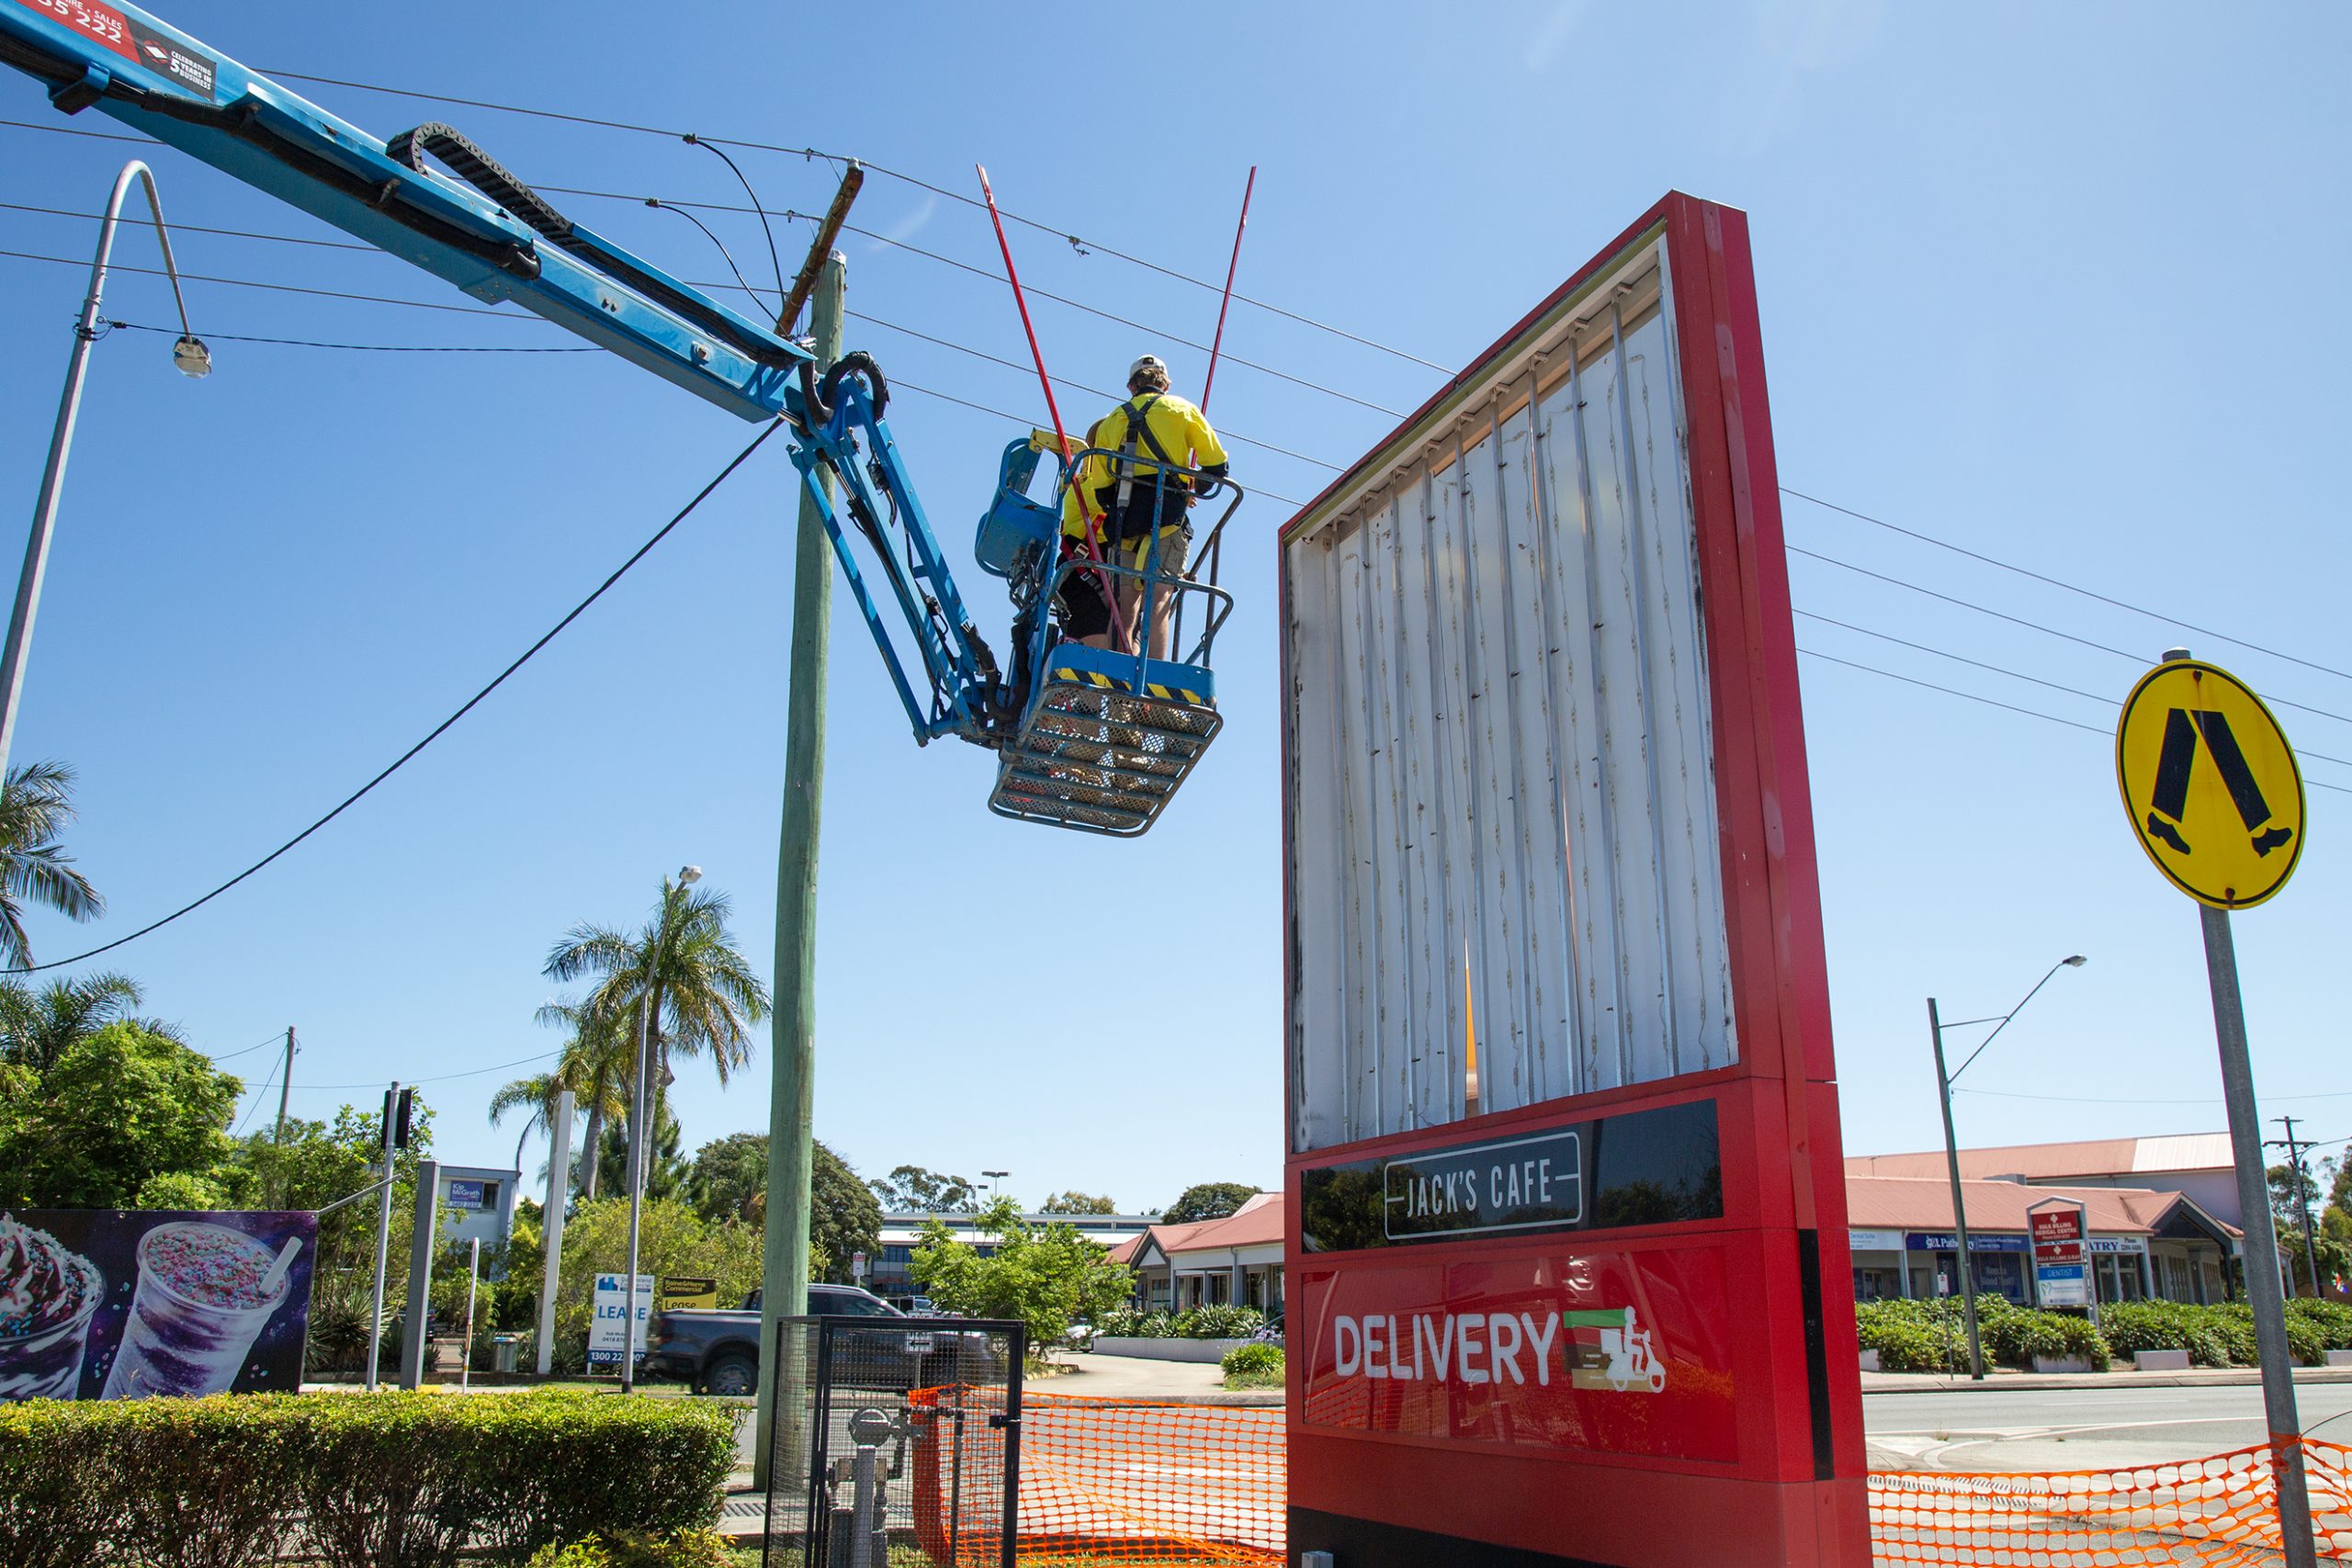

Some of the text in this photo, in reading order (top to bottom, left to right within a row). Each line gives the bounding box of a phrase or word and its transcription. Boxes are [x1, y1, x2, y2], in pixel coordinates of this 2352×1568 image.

[75, 10, 122, 44] 222
[94, 10, 122, 30] SALES
[170, 57, 180, 73] 5
[180, 62, 202, 79] YEARS
[172, 51, 212, 76] CELEBRATING
[179, 69, 211, 90] BUSINESS
[1408, 1158, 1552, 1218] JACK'S CAFE
[2047, 1268, 2073, 1277] DENTIST
[598, 1305, 647, 1320] LEAE
[665, 1300, 696, 1309] Lease
[591, 1351, 611, 1361] 1300
[1335, 1312, 1559, 1386] DELIVERY
